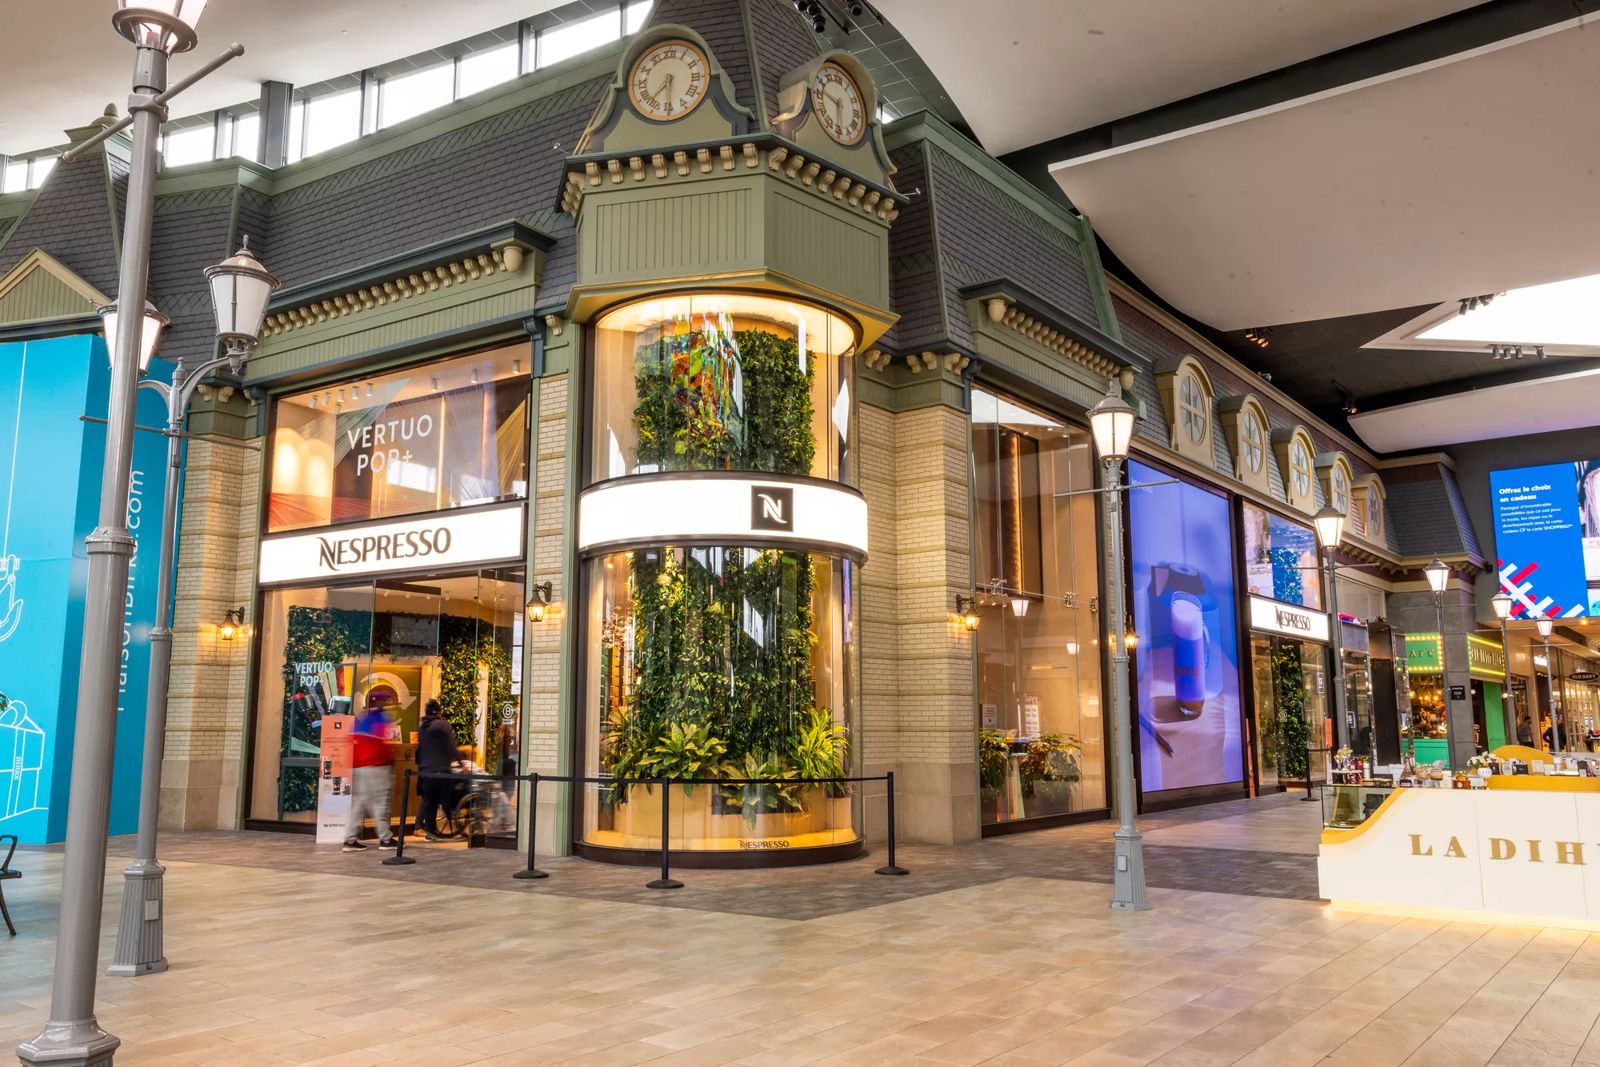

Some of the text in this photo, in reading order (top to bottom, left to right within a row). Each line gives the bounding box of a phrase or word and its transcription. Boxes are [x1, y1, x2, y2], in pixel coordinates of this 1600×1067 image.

[347, 415, 433, 450] VERTUO
[356, 448, 413, 476] POP+
[1510, 494, 1537, 502] cadeau
[317, 527, 452, 571] NESPRESSO
[1275, 604, 1311, 631] NESPRESSO
[295, 661, 332, 673] VERTUO
[300, 675, 325, 687] POP+
[738, 840, 790, 850] NESPRESSO
[1408, 834, 1600, 865] LA DIH
